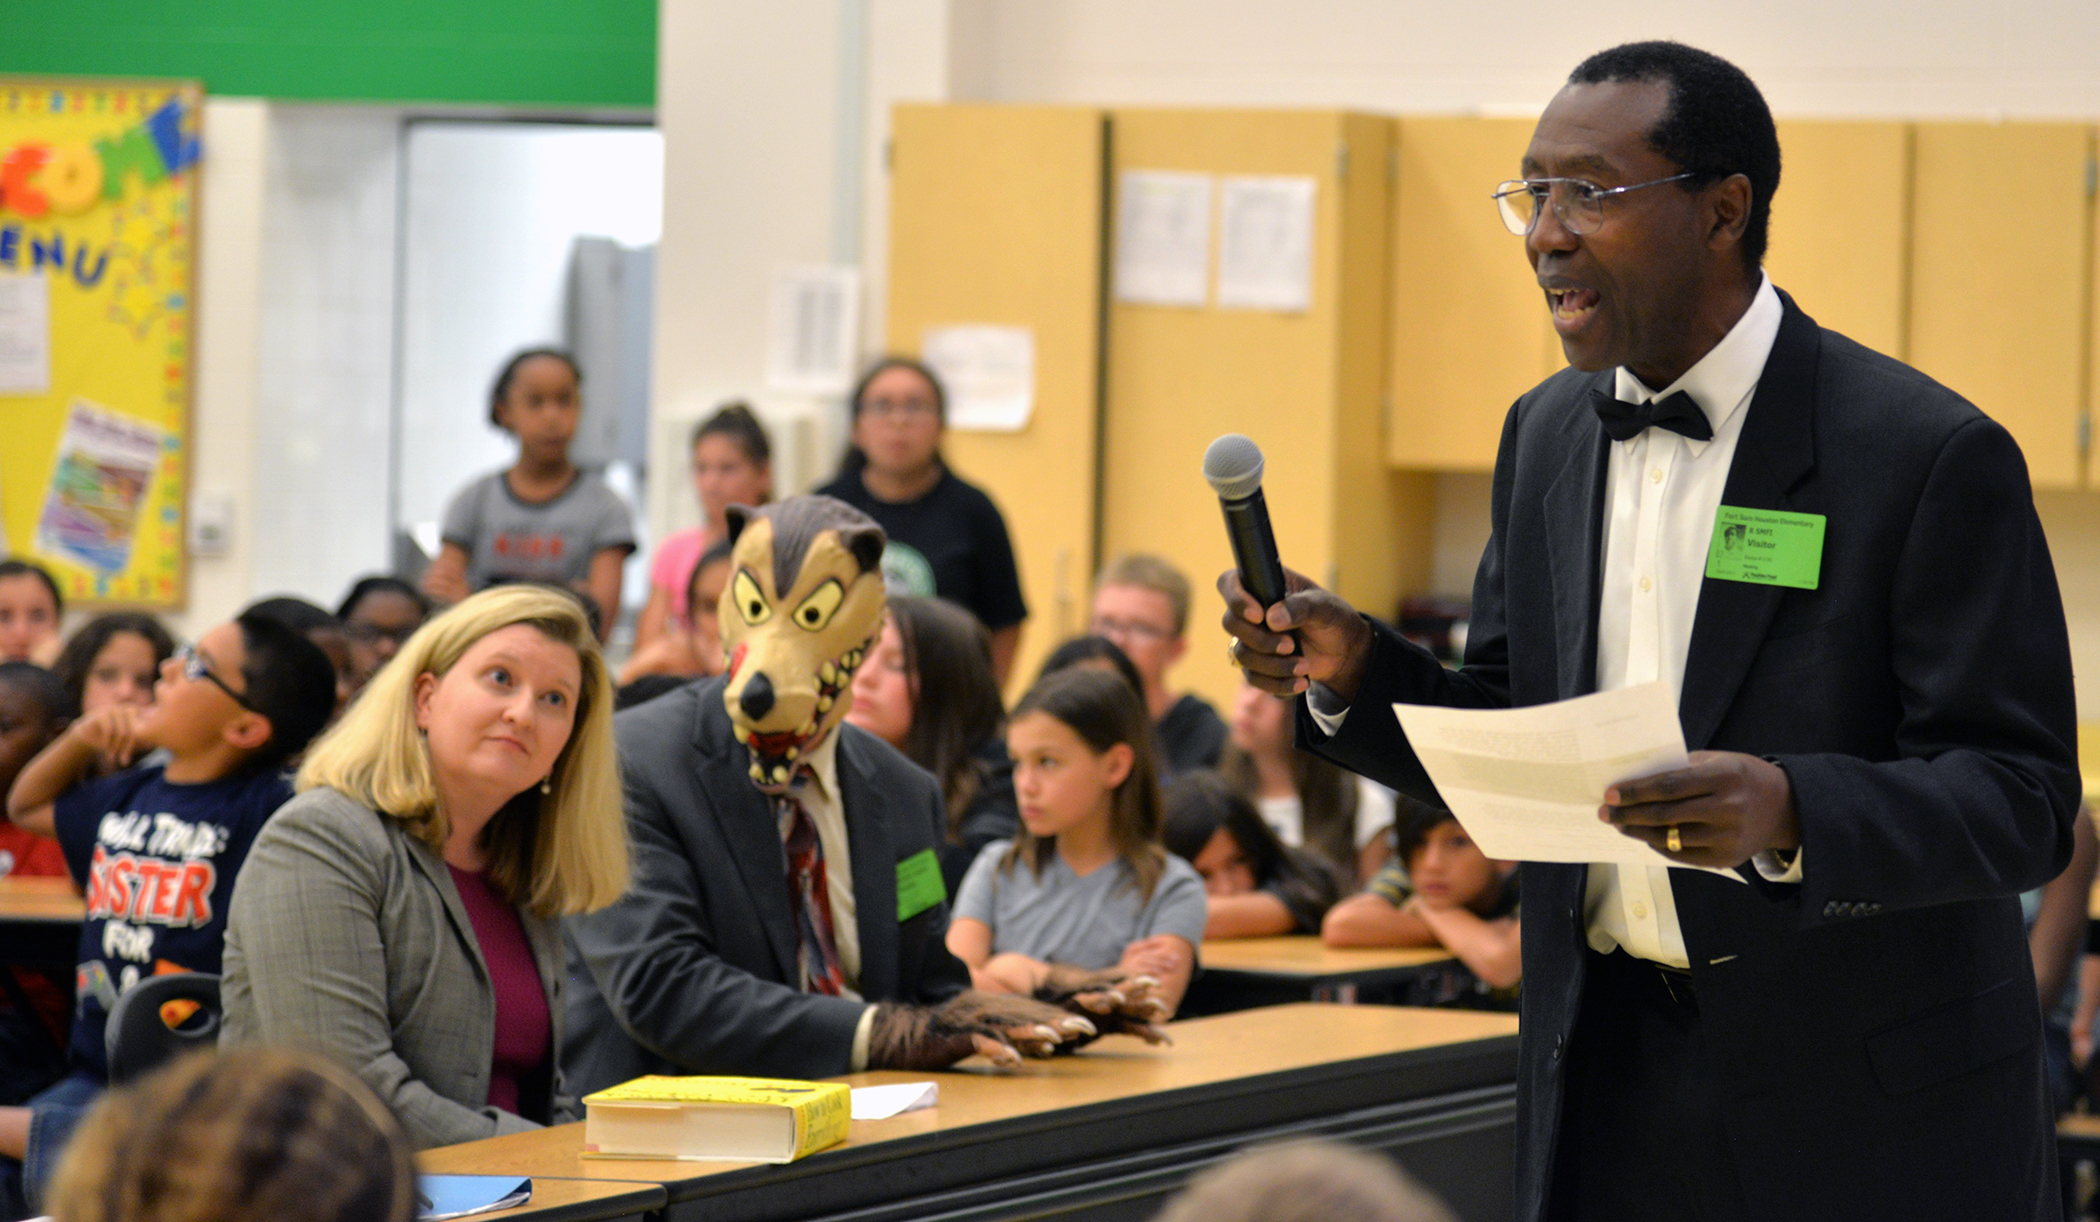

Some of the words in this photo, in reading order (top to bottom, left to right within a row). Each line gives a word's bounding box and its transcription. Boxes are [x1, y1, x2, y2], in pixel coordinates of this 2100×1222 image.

[1725, 512, 1738, 520] Fort
[1740, 513, 1753, 521] Sam
[1755, 515, 1778, 524] Houston
[1780, 518, 1814, 528] Elementary
[1747, 539, 1776, 549] Visitor
[87, 843, 216, 929] SISTER
[103, 920, 154, 963] FOR
